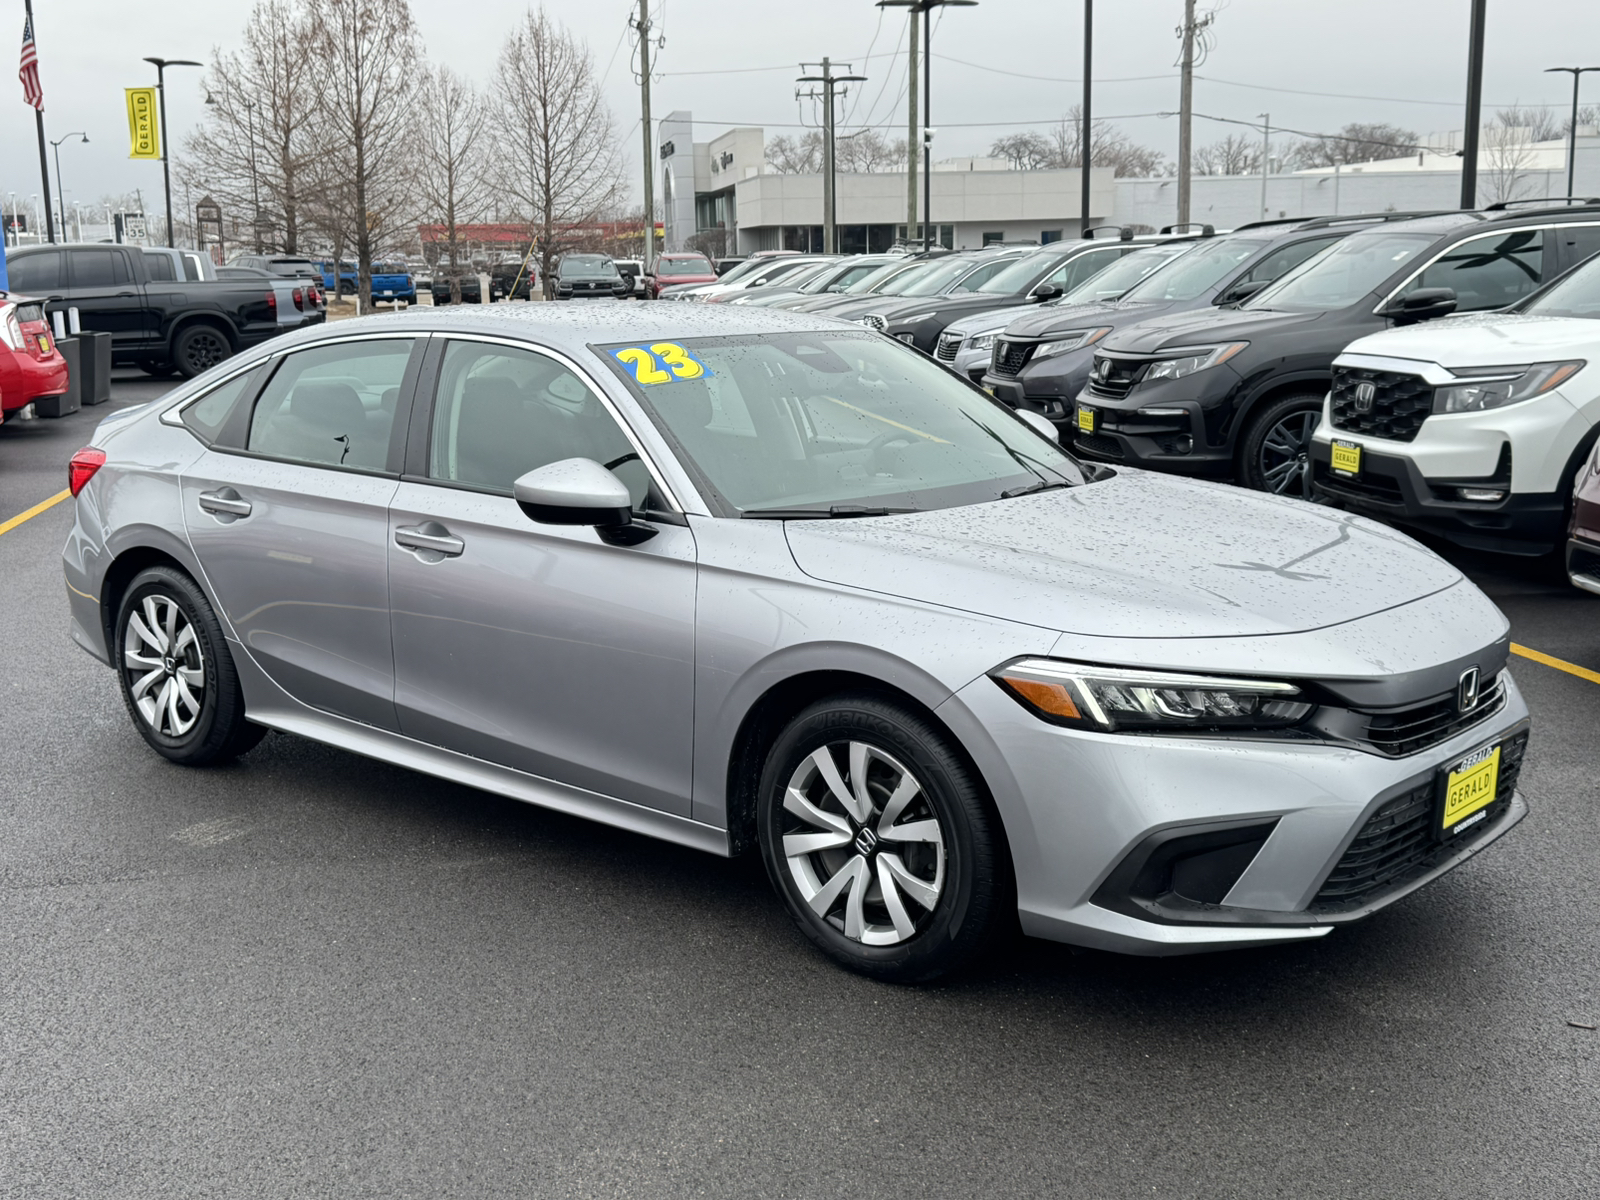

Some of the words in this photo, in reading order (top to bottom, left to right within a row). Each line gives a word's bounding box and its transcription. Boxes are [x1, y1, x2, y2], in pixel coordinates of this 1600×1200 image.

[138, 97, 149, 149] GERALD
[130, 229, 145, 237] 35
[616, 343, 704, 384] 23
[1335, 452, 1357, 464] GERALD
[1451, 773, 1490, 807] GERALD
